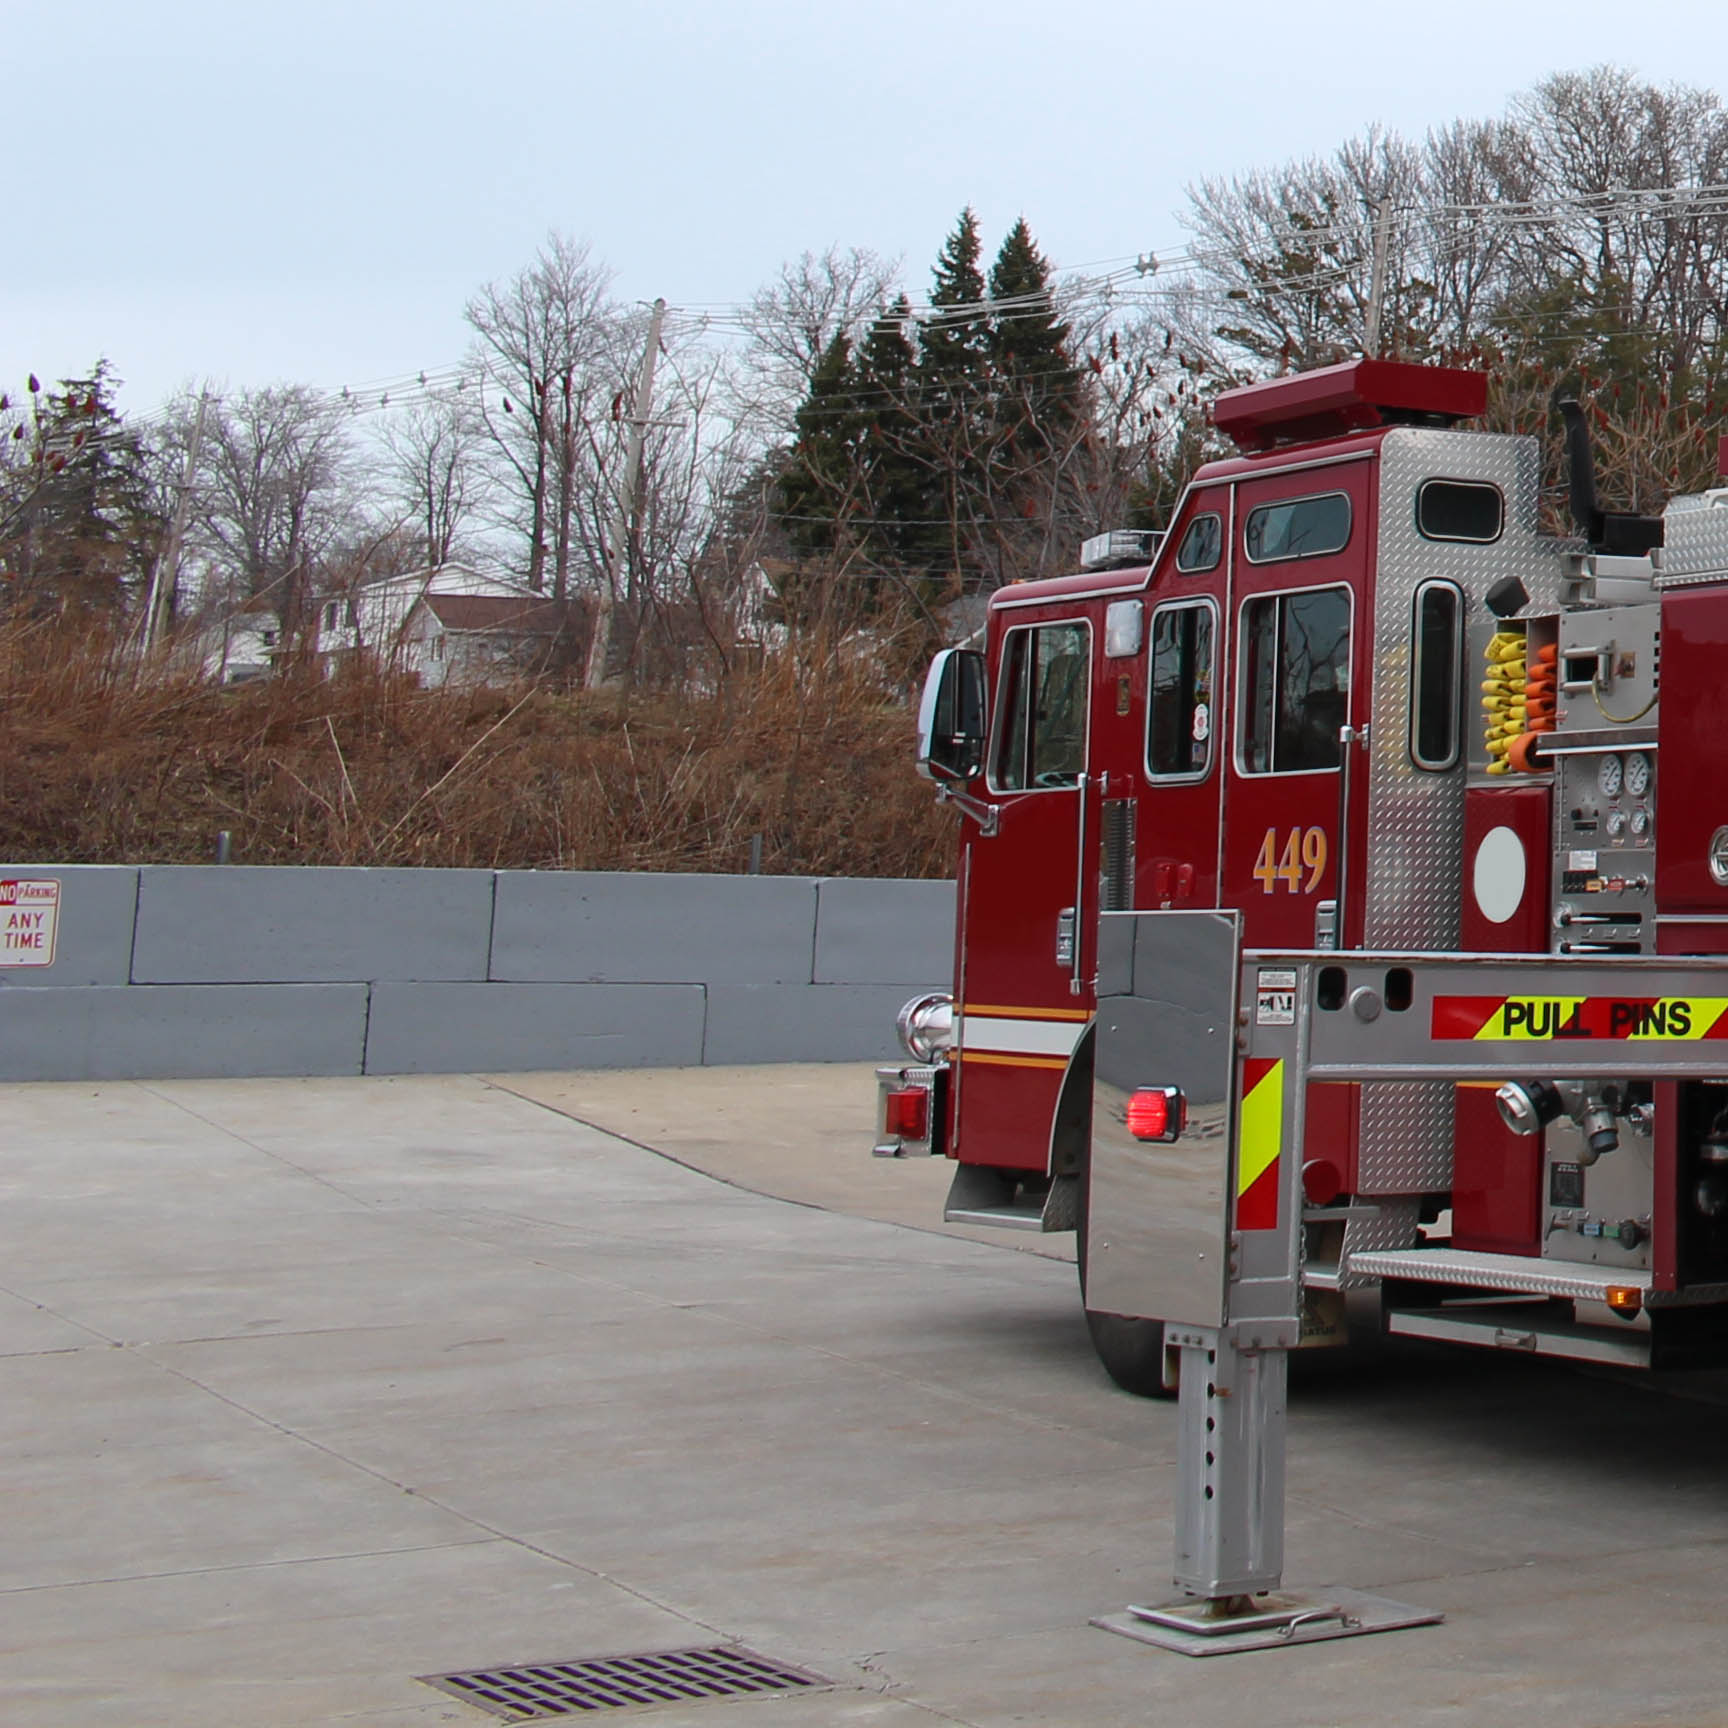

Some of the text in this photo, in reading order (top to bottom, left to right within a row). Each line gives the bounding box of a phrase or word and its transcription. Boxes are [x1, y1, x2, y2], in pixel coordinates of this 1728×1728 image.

[1253, 826, 1327, 894] 449
[0, 885, 57, 902] NO PARKING
[8, 912, 44, 928] ANY
[4, 933, 44, 948] TIME
[1503, 1001, 1692, 1036] PULL PINS
